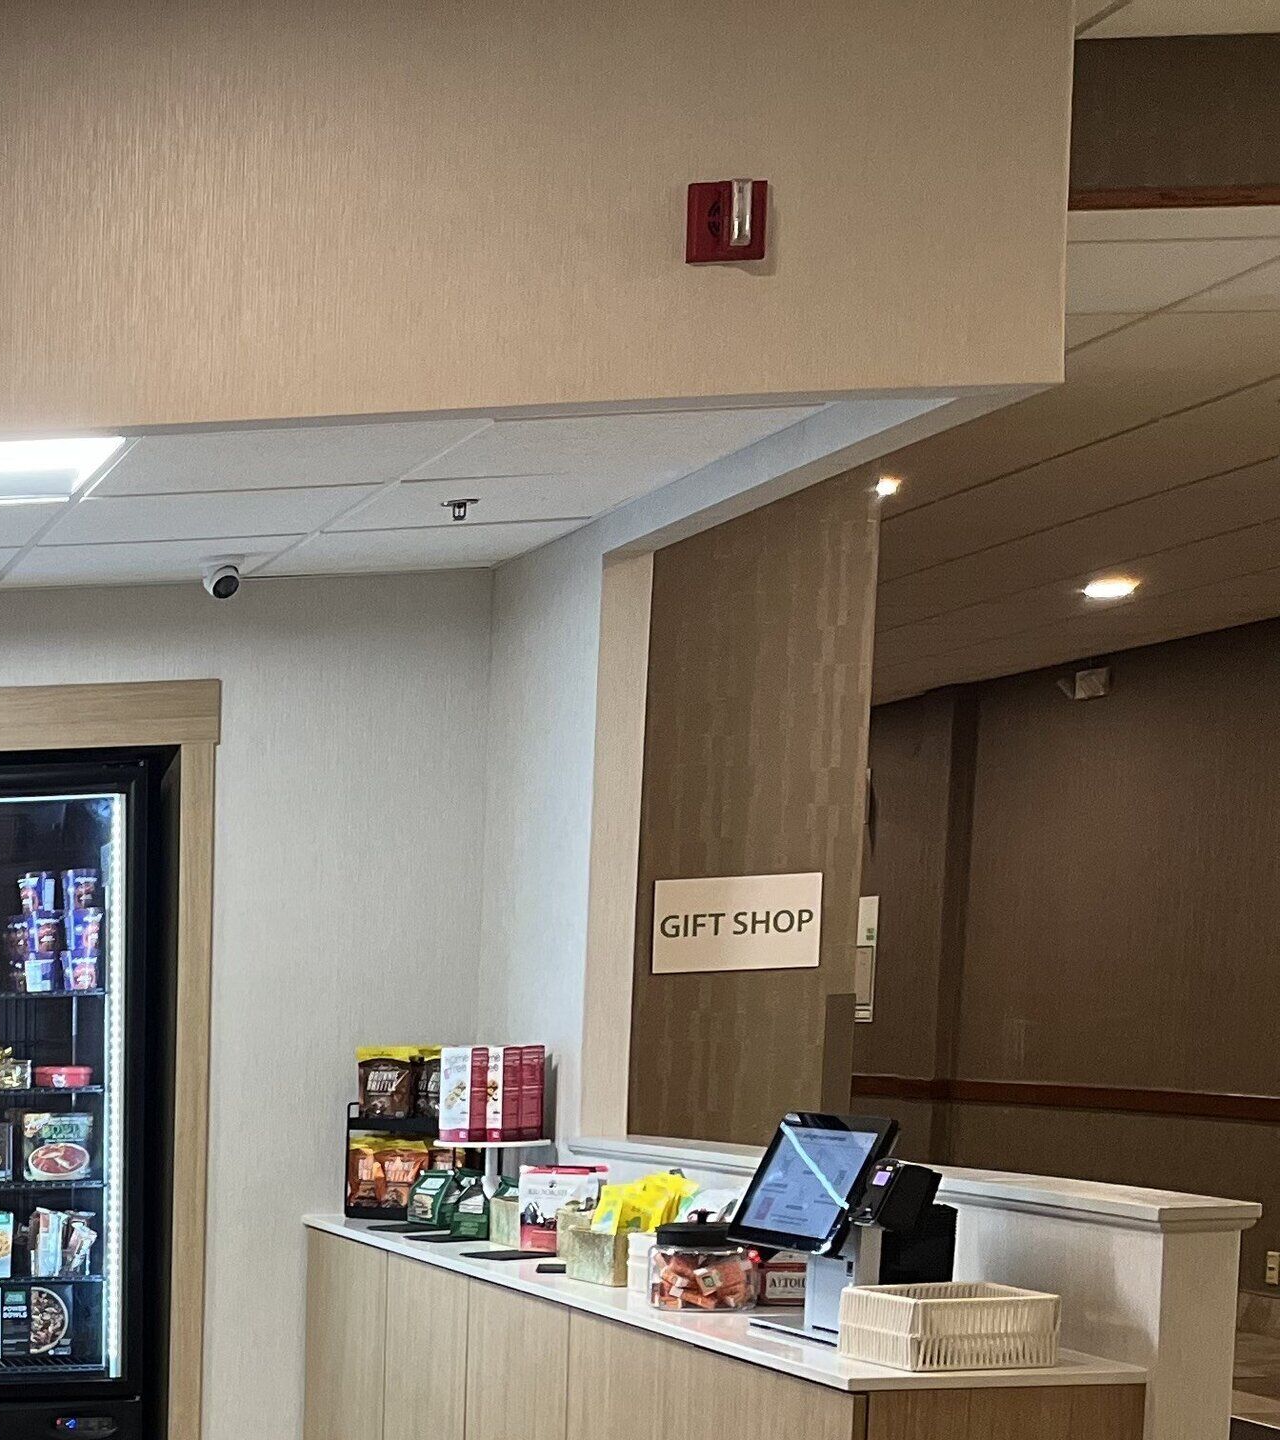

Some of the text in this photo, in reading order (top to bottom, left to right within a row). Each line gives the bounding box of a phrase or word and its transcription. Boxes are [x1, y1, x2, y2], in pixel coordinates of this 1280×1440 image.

[660, 909, 814, 938] GIFT SHOP
[769, 1276, 806, 1289] ALTOI
